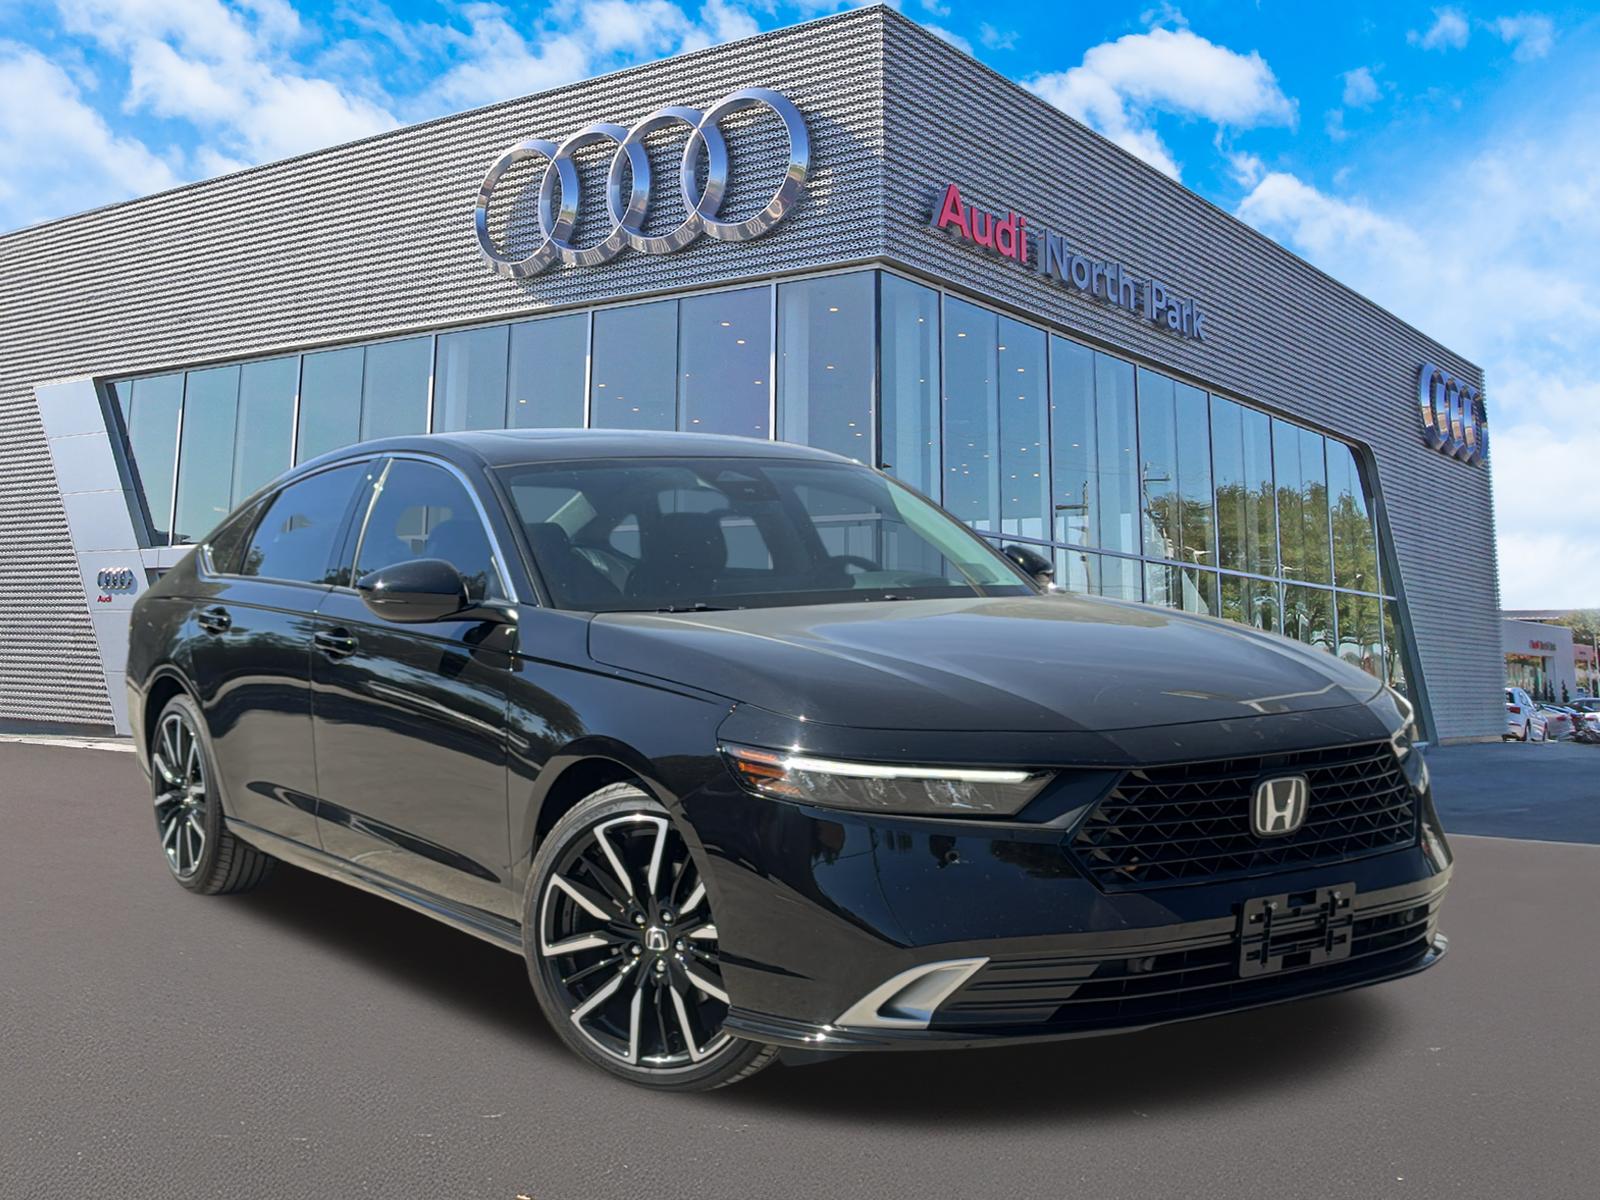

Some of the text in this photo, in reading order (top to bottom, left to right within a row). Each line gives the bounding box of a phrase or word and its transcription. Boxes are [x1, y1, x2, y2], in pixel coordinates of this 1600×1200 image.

[934, 183, 1208, 341] Audi North Park
